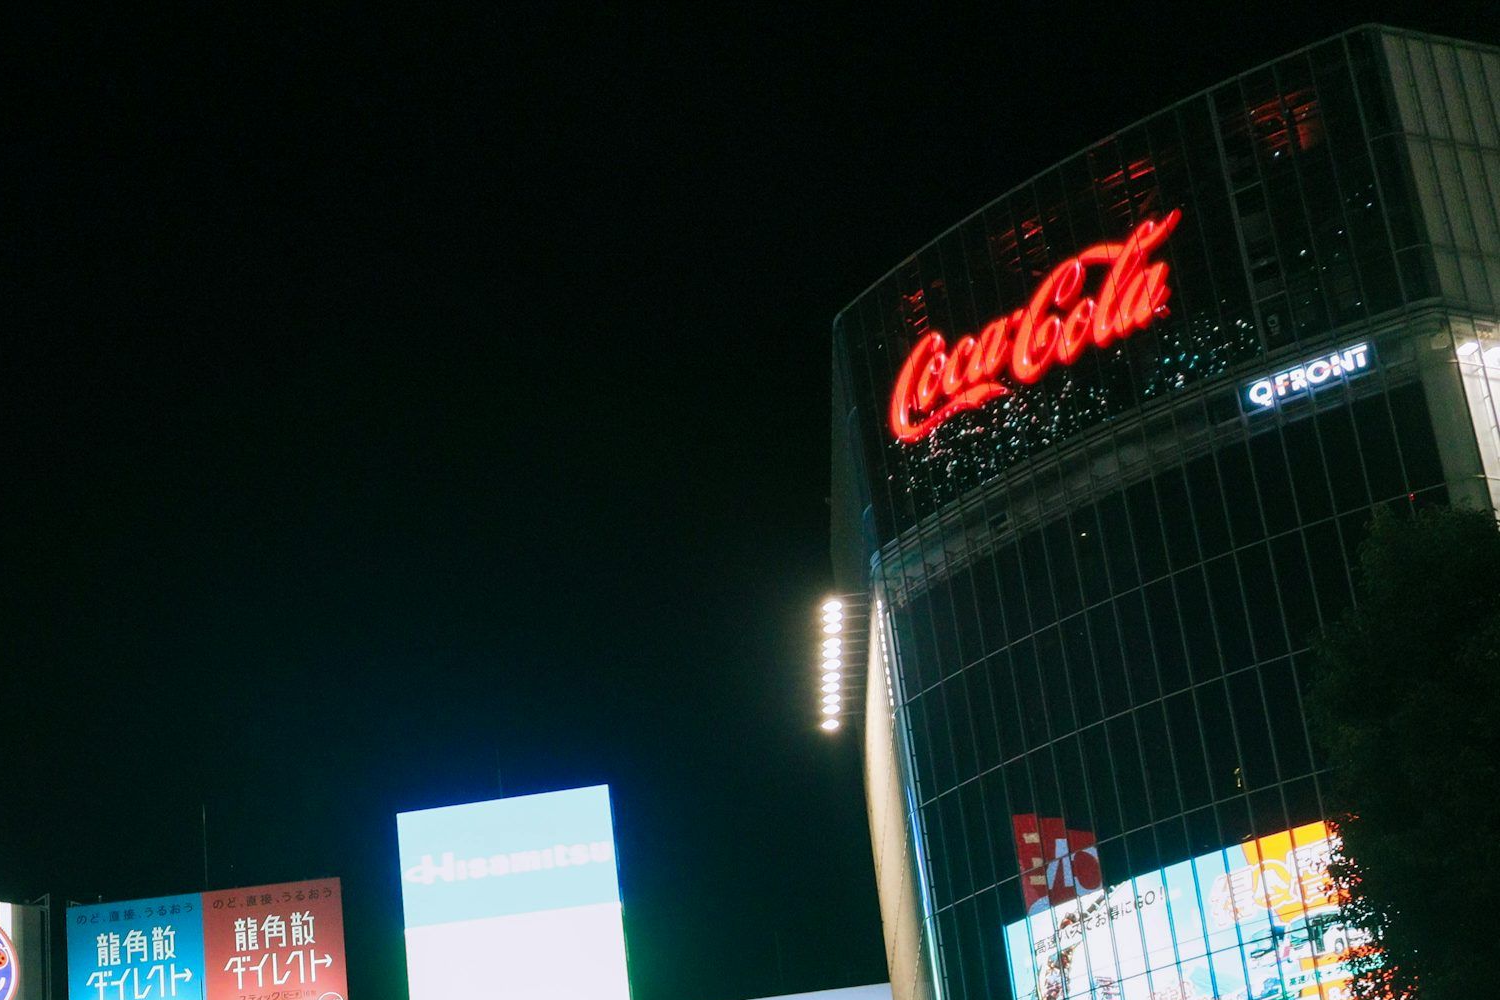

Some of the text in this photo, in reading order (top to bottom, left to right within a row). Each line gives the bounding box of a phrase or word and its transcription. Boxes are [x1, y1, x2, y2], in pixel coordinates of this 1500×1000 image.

[889, 208, 1182, 443] Coca-Cola
[96, 925, 176, 967] 龍角散
[234, 911, 315, 952] 龍角散
